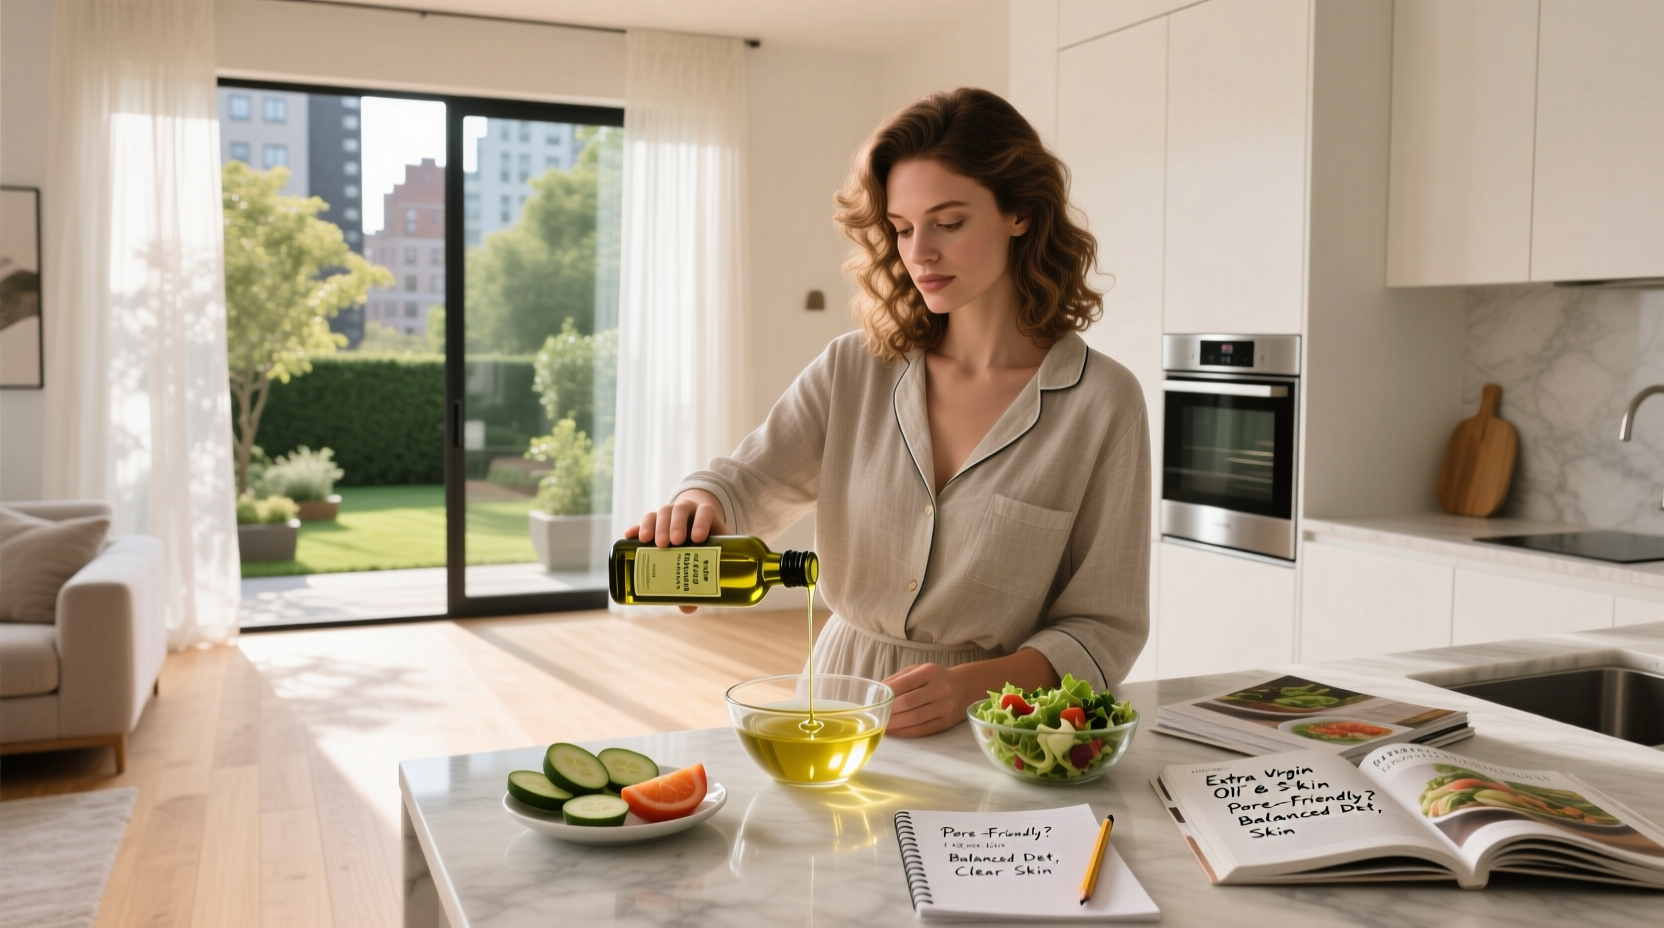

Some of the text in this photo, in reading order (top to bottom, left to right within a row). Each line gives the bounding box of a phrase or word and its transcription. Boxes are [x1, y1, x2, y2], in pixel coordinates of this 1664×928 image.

[1206, 774, 1256, 786] Extra
[1277, 780, 1330, 792] Skin
[1238, 806, 1330, 826] Balanced
[1249, 827, 1296, 839] Skin
[949, 853, 1015, 863] Balanced
[955, 865, 1052, 877] Clear Skin
